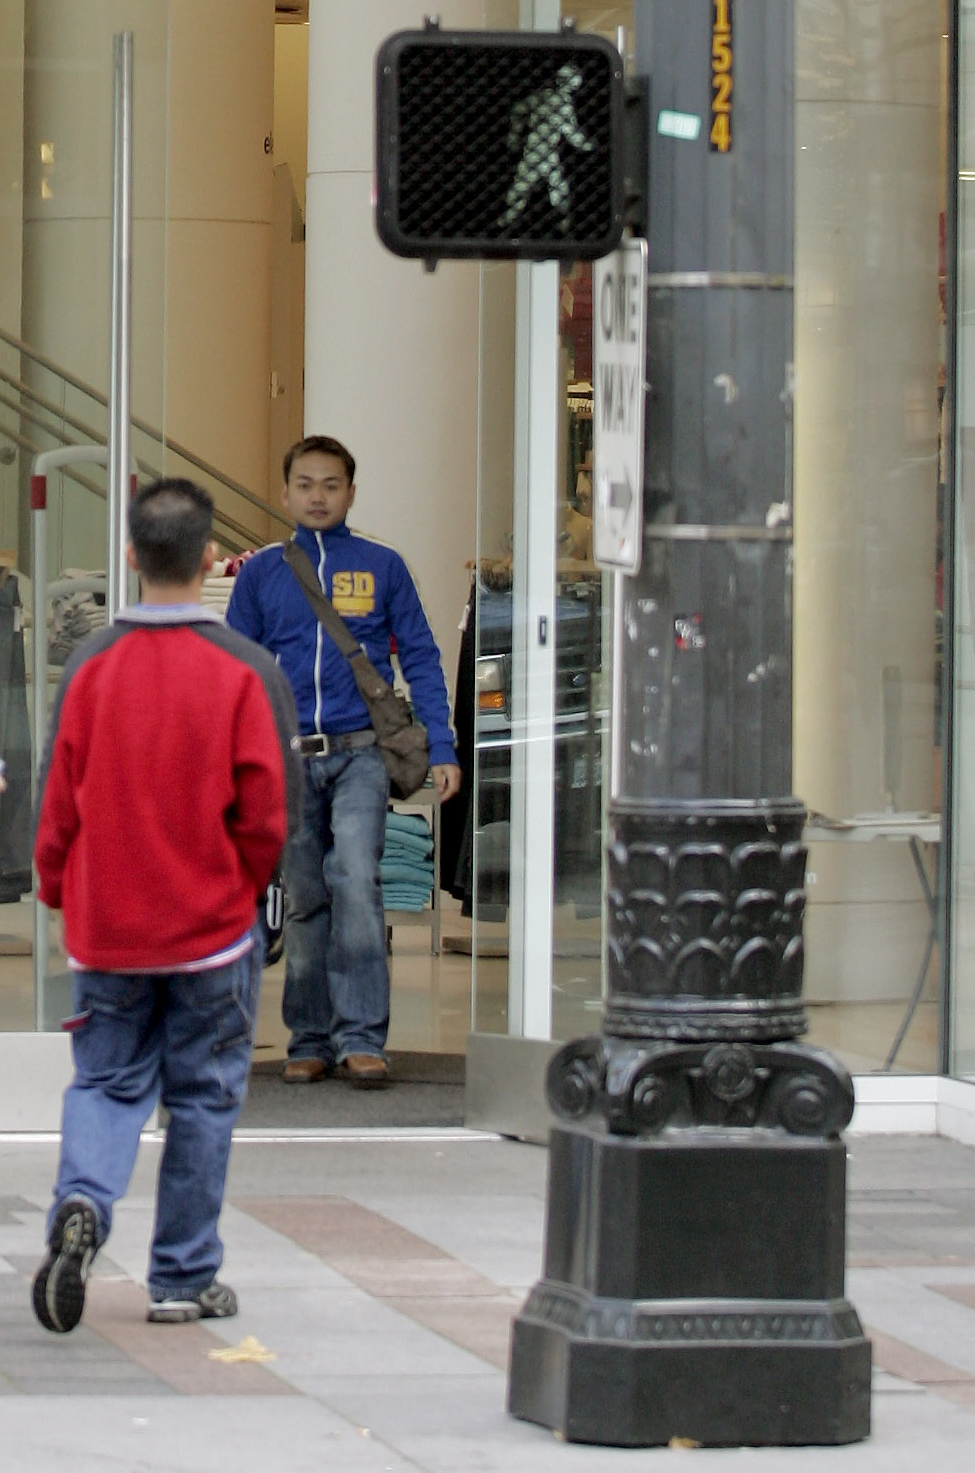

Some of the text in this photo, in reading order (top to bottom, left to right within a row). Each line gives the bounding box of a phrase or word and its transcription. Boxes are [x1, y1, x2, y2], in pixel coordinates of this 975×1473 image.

[600, 273, 638, 345] ONE
[599, 363, 641, 434] WAY
[332, 571, 374, 597] SD
